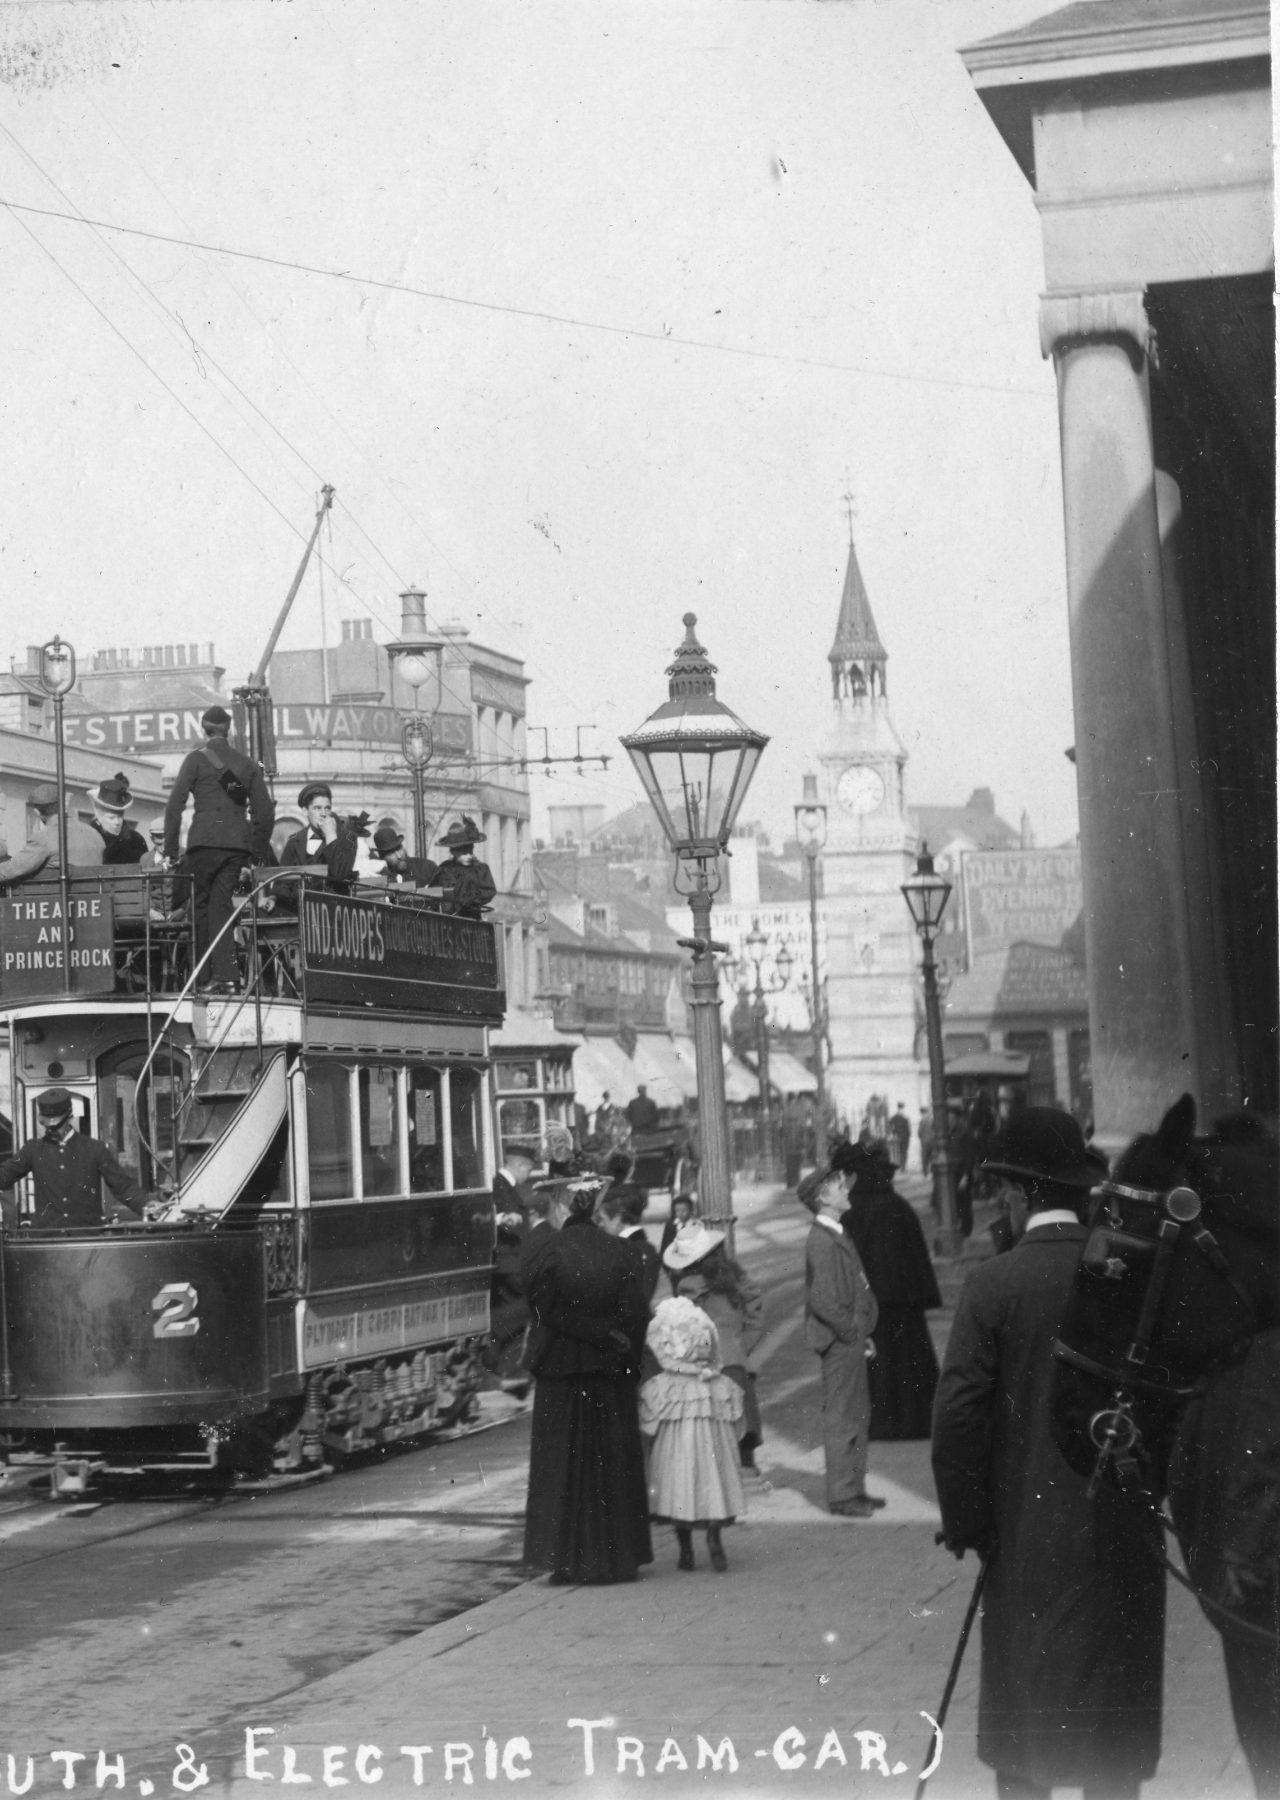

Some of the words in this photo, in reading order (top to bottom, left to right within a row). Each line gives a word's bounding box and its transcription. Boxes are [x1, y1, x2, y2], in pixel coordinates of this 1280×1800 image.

[50, 711, 206, 746] ESTERN
[12, 900, 101, 920] THEATRE
[5, 951, 64, 970] PRINCE
[70, 948, 112, 967] ROCK
[152, 1282, 200, 1338] 2
